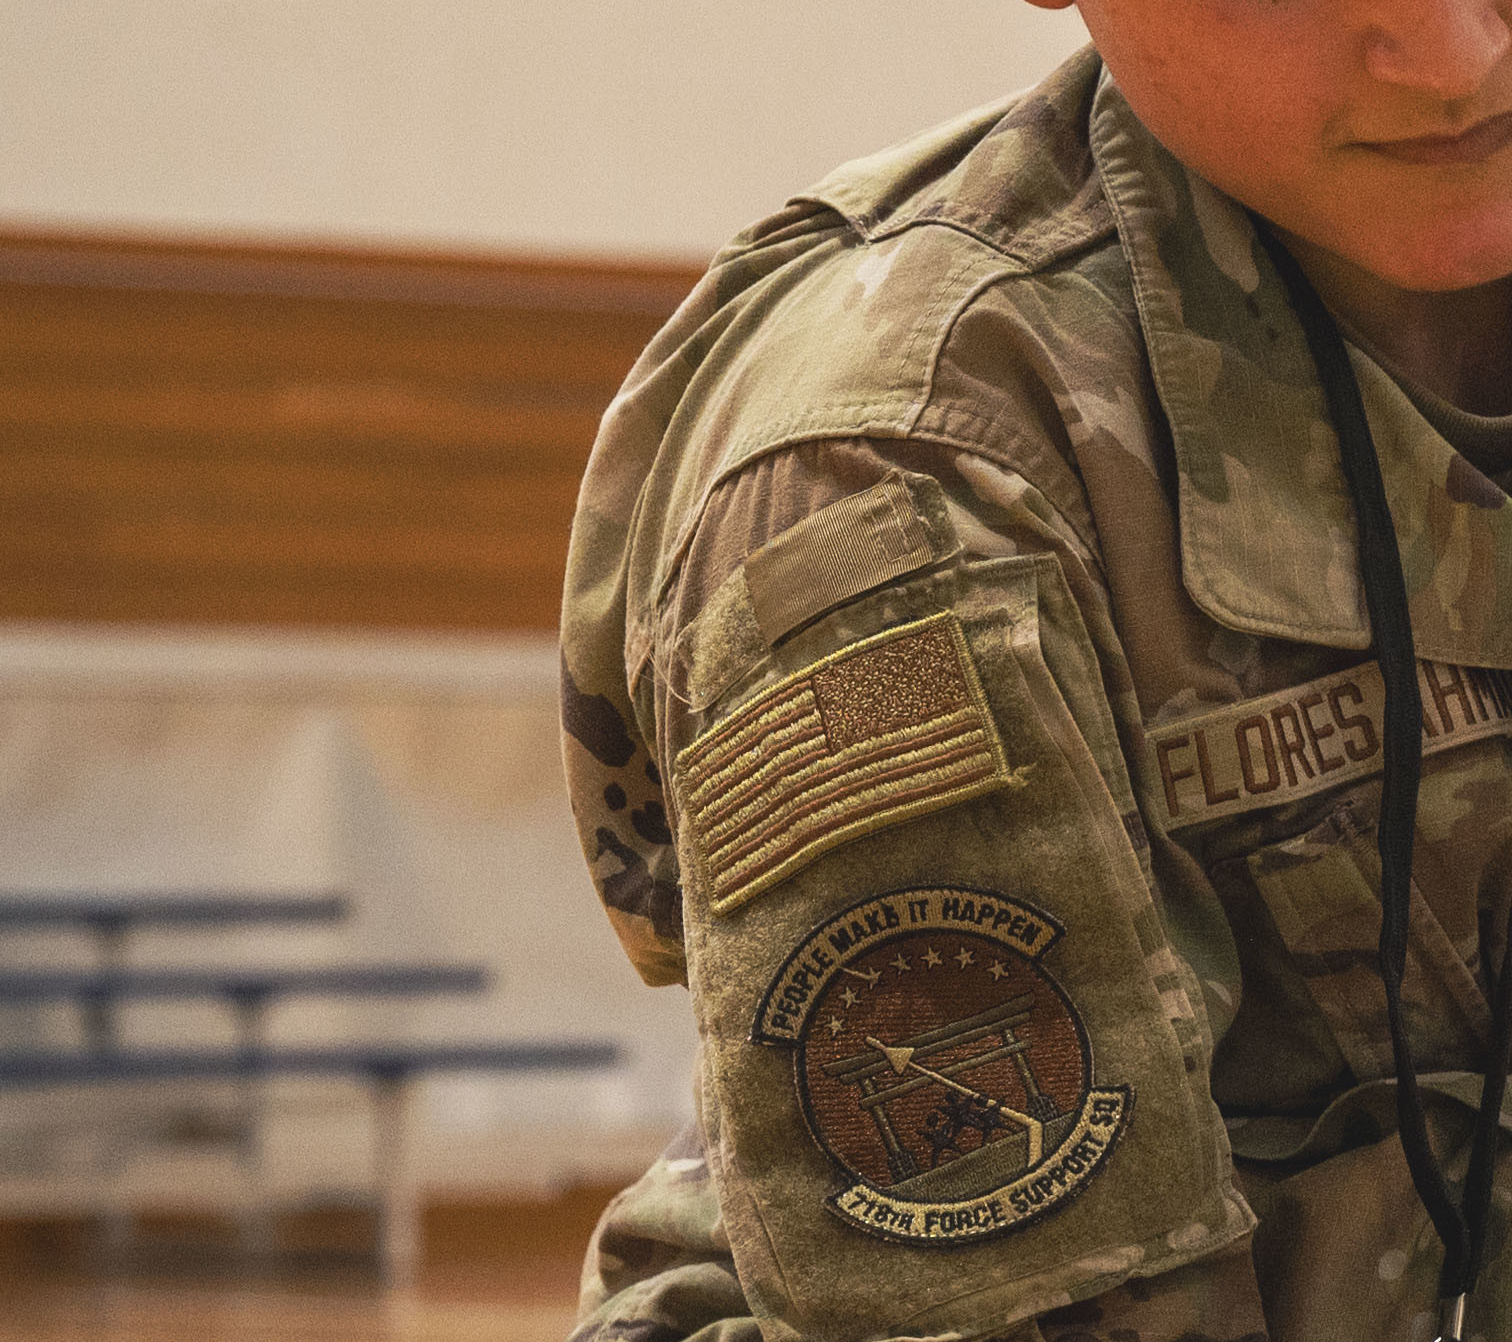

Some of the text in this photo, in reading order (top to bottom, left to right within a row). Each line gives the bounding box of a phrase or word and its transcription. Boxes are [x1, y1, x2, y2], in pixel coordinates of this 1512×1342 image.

[1155, 681, 1380, 818] FLORES
[770, 897, 1043, 1031] PEOPLE MAKE IT HAPPEN
[923, 1200, 1008, 1230] FORCE
[1008, 1131, 1106, 1214] SUPPORT
[1088, 1098, 1119, 1128] SQ
